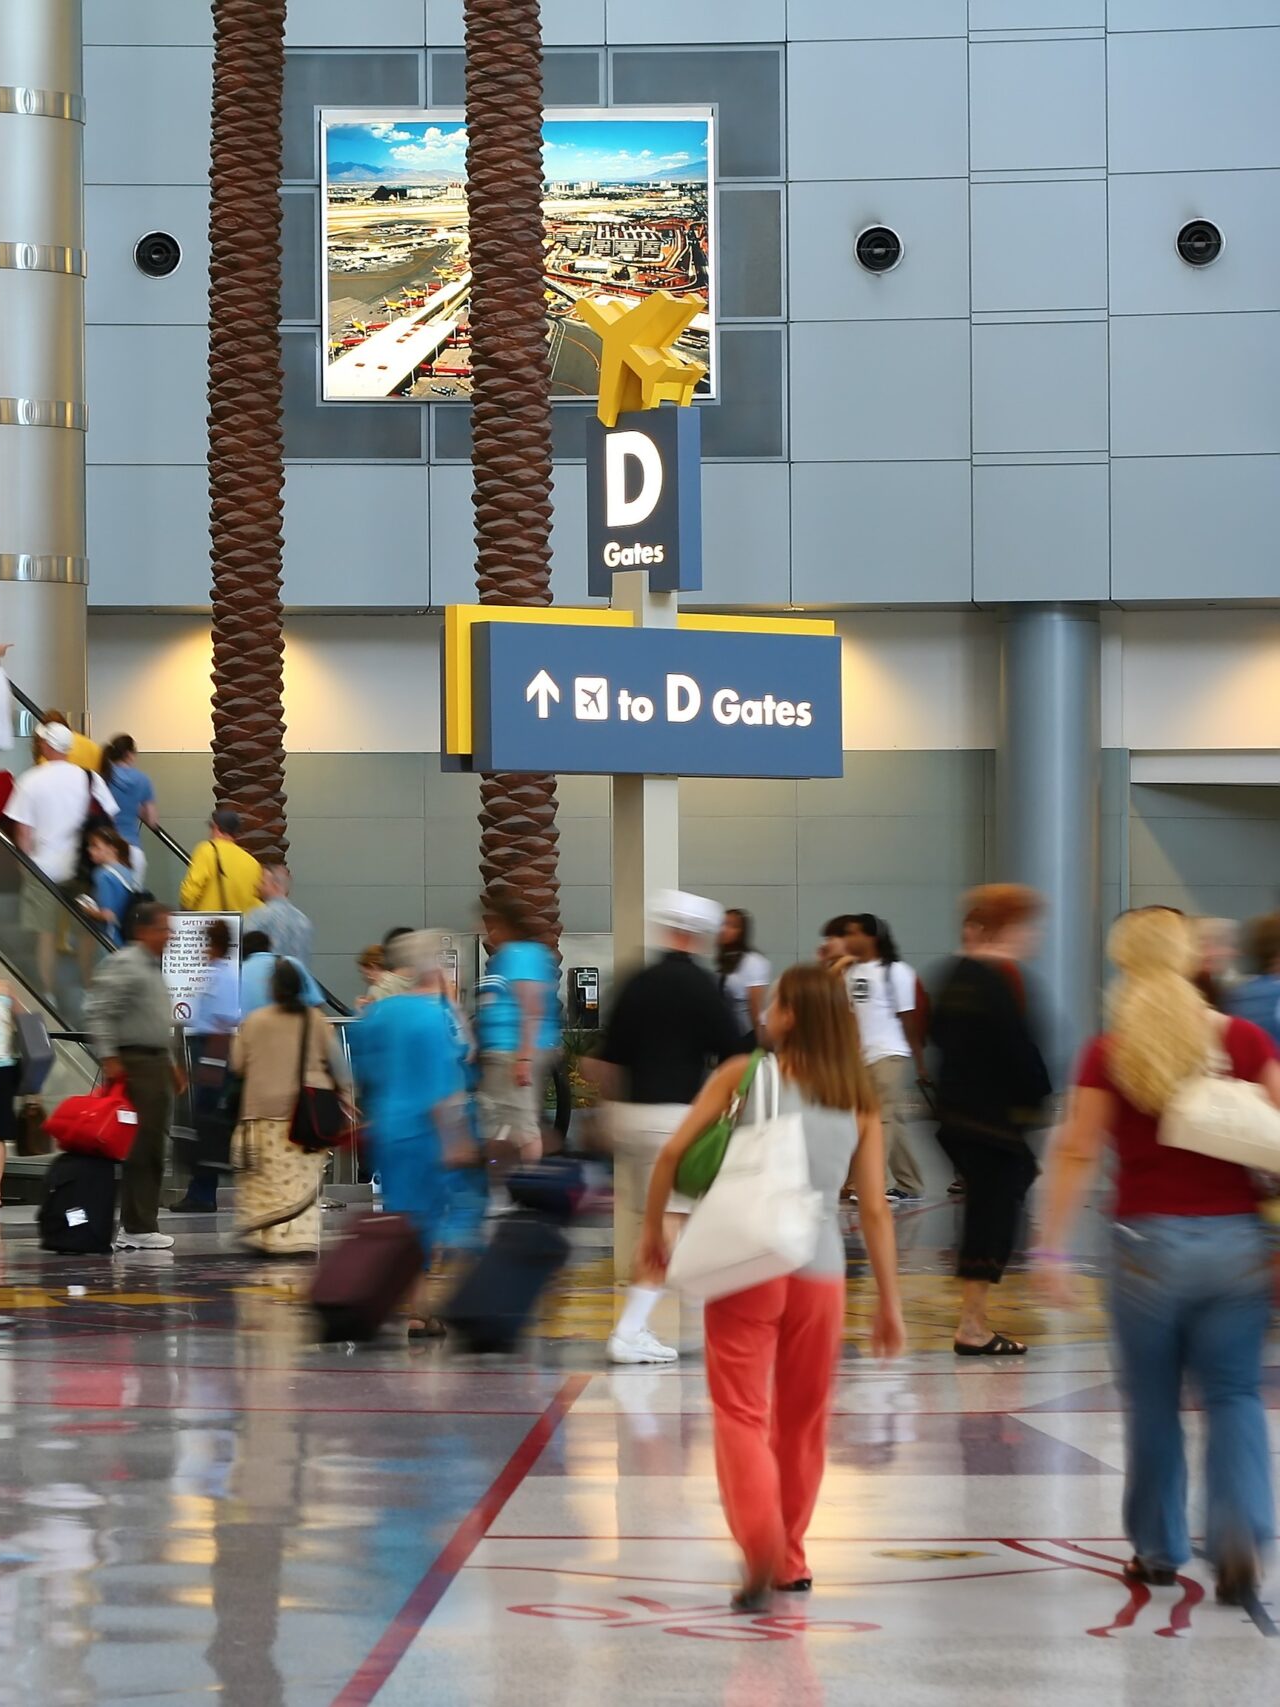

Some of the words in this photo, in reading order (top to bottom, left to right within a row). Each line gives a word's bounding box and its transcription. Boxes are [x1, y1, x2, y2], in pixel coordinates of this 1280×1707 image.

[605, 430, 663, 527] D
[604, 542, 664, 567] Gates
[618, 690, 654, 722] to
[666, 673, 702, 723] D
[712, 689, 812, 727] Gates
